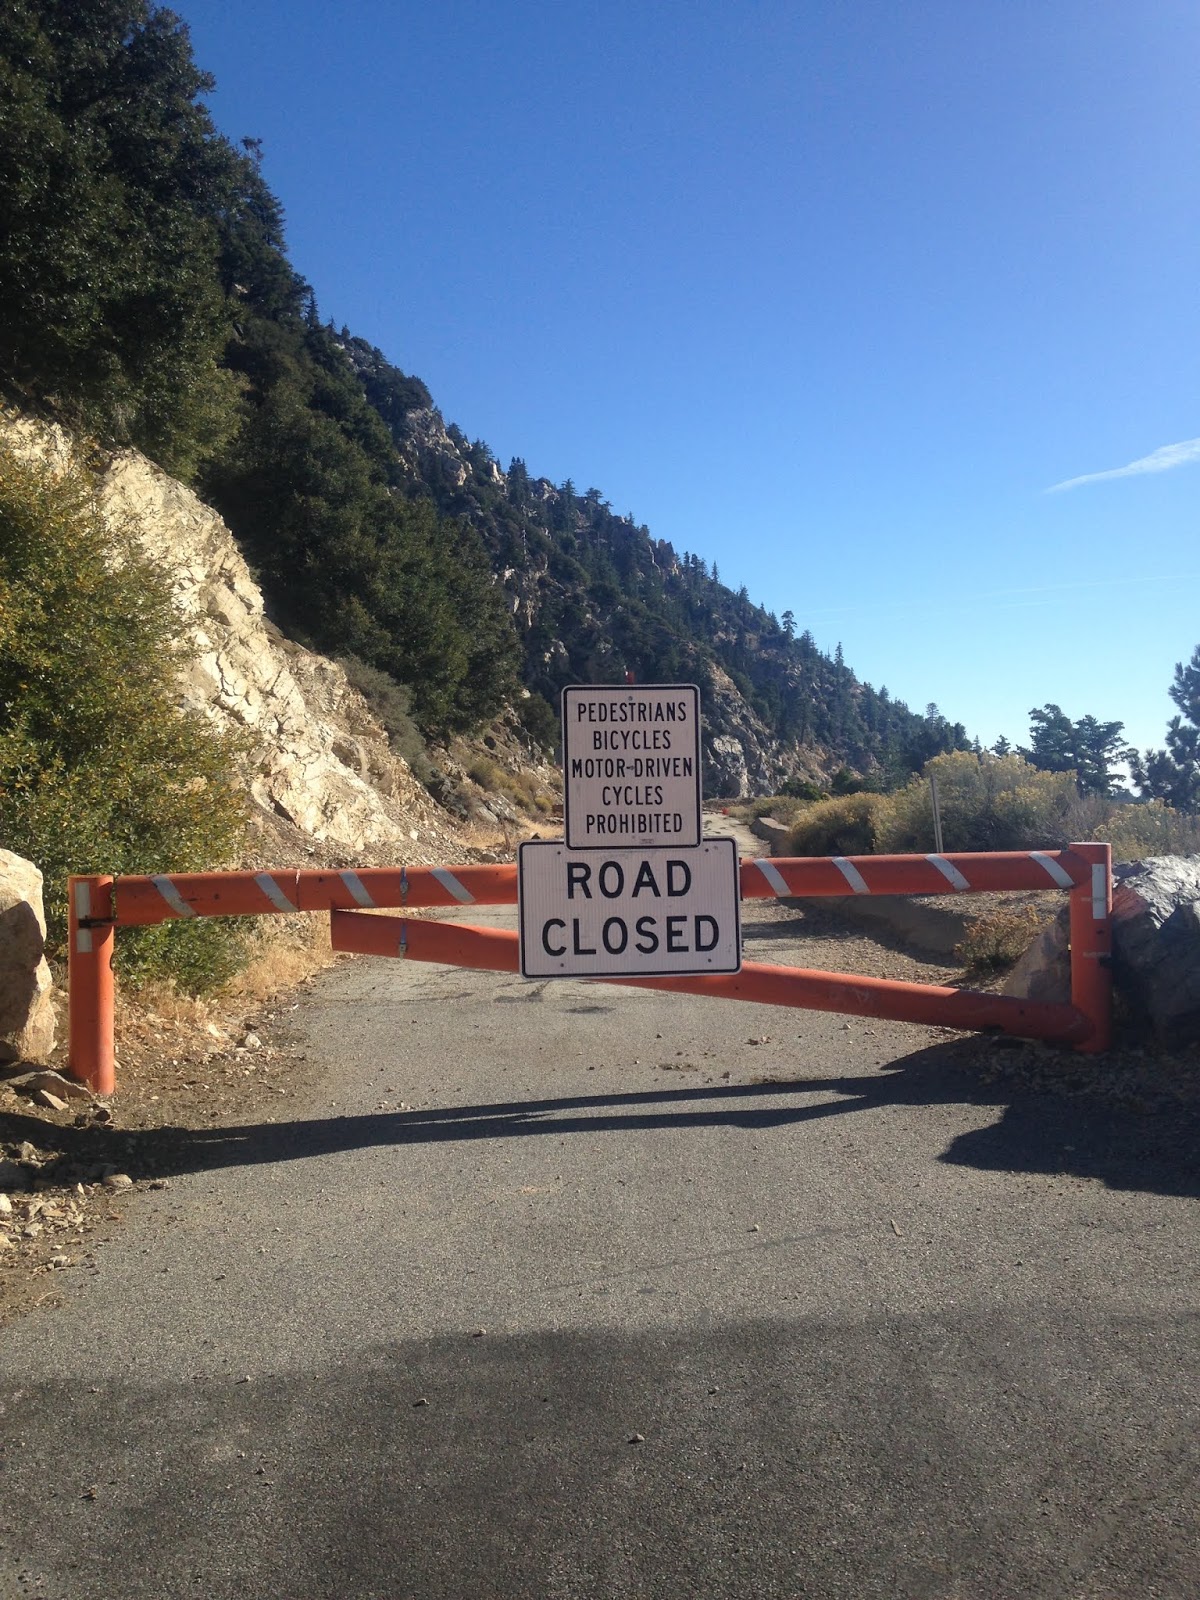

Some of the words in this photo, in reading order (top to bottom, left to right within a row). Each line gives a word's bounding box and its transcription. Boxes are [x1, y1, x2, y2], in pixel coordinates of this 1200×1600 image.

[578, 702, 687, 722] PEDESTRIANS
[593, 730, 671, 750] BICYCLES
[572, 758, 693, 778] MOTOR-DRIVEN
[602, 786, 663, 806] CYCLES
[586, 813, 683, 834] PROHIBITED
[566, 860, 692, 899] ROAD
[541, 915, 720, 956] CLOSED
